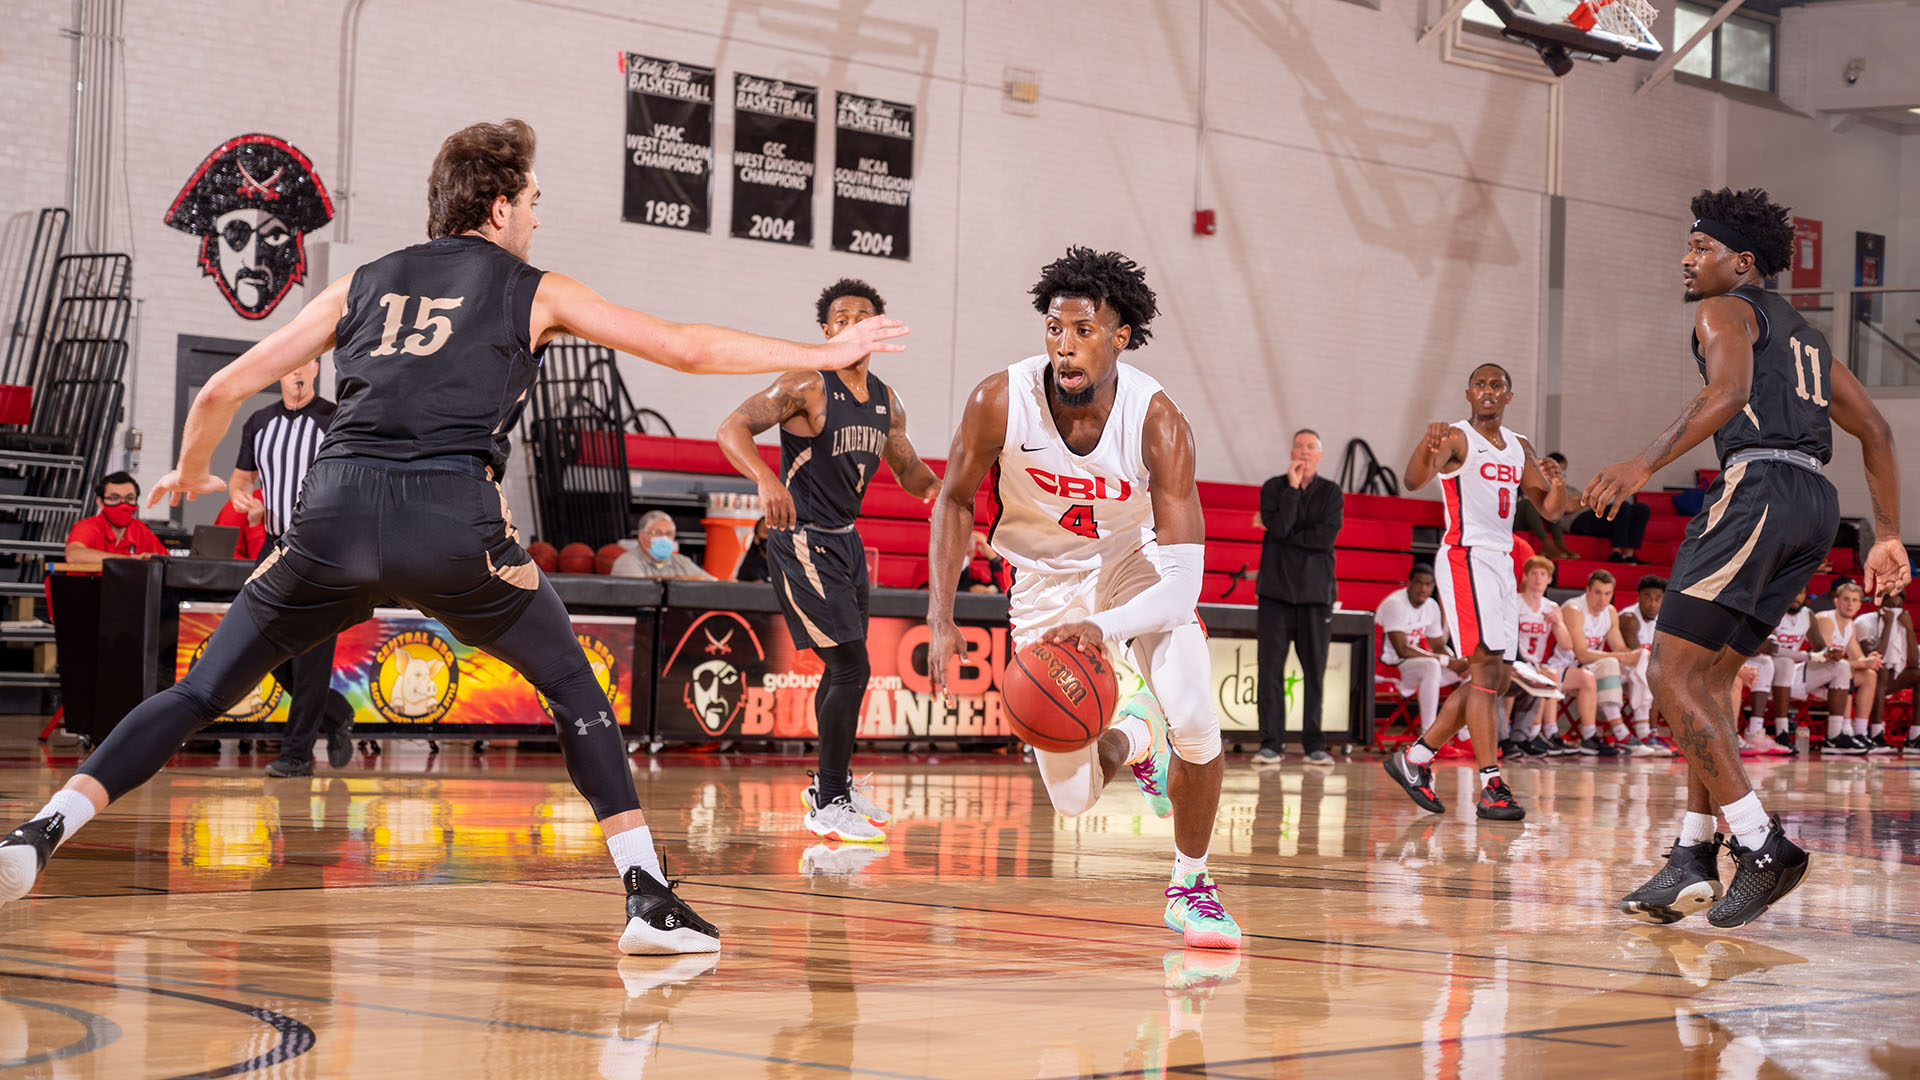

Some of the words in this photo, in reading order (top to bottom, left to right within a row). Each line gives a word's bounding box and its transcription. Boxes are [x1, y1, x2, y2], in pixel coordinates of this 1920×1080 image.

[629, 72, 710, 101] BASKETBALL
[736, 91, 813, 119] BASKETBALL
[654, 123, 685, 142] VSAC
[837, 110, 911, 136] BASKETBALL
[626, 133, 658, 156] WEST
[658, 139, 712, 161] DIVISION
[762, 141, 787, 158] GSC
[633, 150, 703, 175] CHAMPIONS
[734, 151, 764, 168] WEST
[764, 157, 814, 178] DIVISION
[858, 157, 889, 176] NCAA
[740, 166, 807, 190] CHAMPIONS
[834, 168, 872, 185] SOUTH
[871, 175, 914, 192] REGION
[837, 182, 910, 206] TOURNAMENT
[645, 199, 691, 227] 1983
[748, 214, 795, 242] 2004
[849, 229, 894, 256] 2004
[370, 292, 465, 357] 15
[1789, 336, 1829, 408] 11
[1025, 467, 1132, 502] CBU
[1480, 462, 1524, 484] CBU
[1498, 487, 1511, 519] 0
[1058, 504, 1100, 539] 4
[376, 631, 429, 664] CENTRAL
[431, 636, 455, 668] BBQ
[593, 639, 615, 670] BBQ
[1527, 637, 1538, 655] 5
[1031, 645, 1088, 708] Wilson
[442, 682, 458, 709] STYLE
